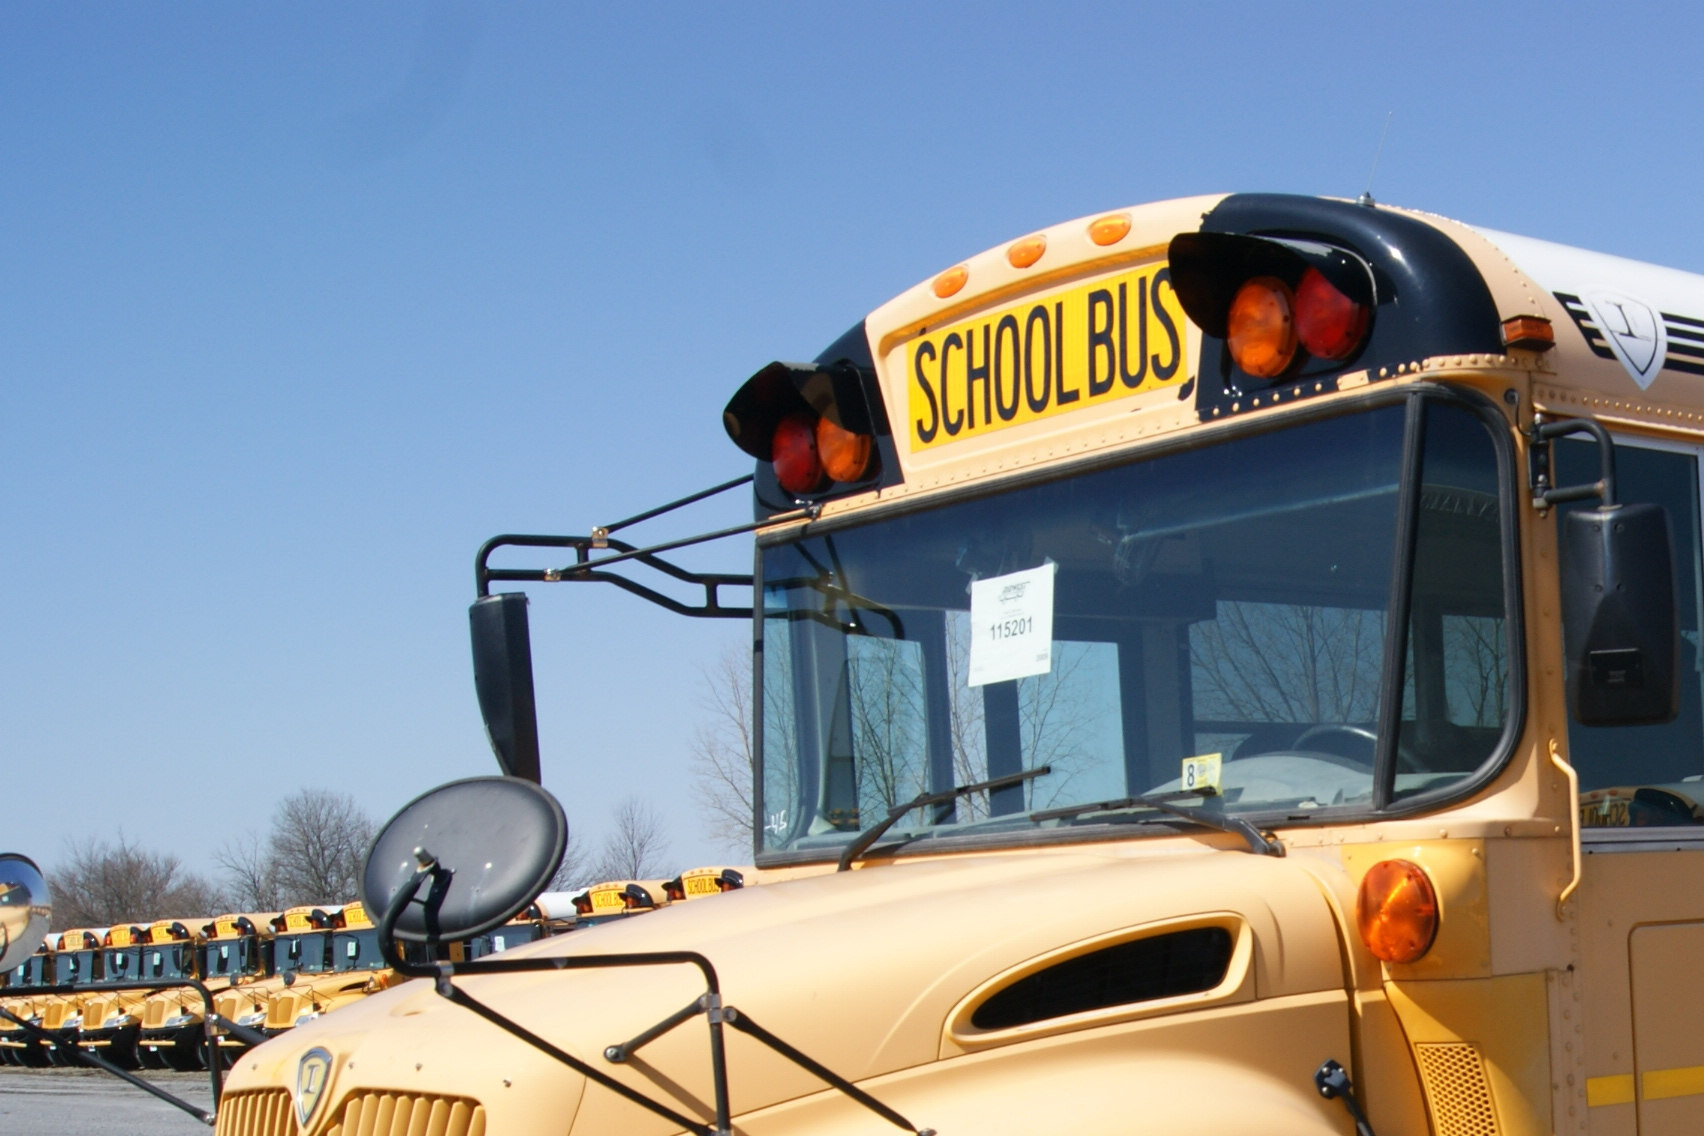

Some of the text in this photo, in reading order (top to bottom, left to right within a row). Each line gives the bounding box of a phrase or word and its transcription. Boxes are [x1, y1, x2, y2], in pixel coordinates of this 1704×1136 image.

[914, 266, 1181, 444] SCHOOL BUS
[990, 615, 1032, 641] 115201
[1187, 764, 1195, 787] 8
